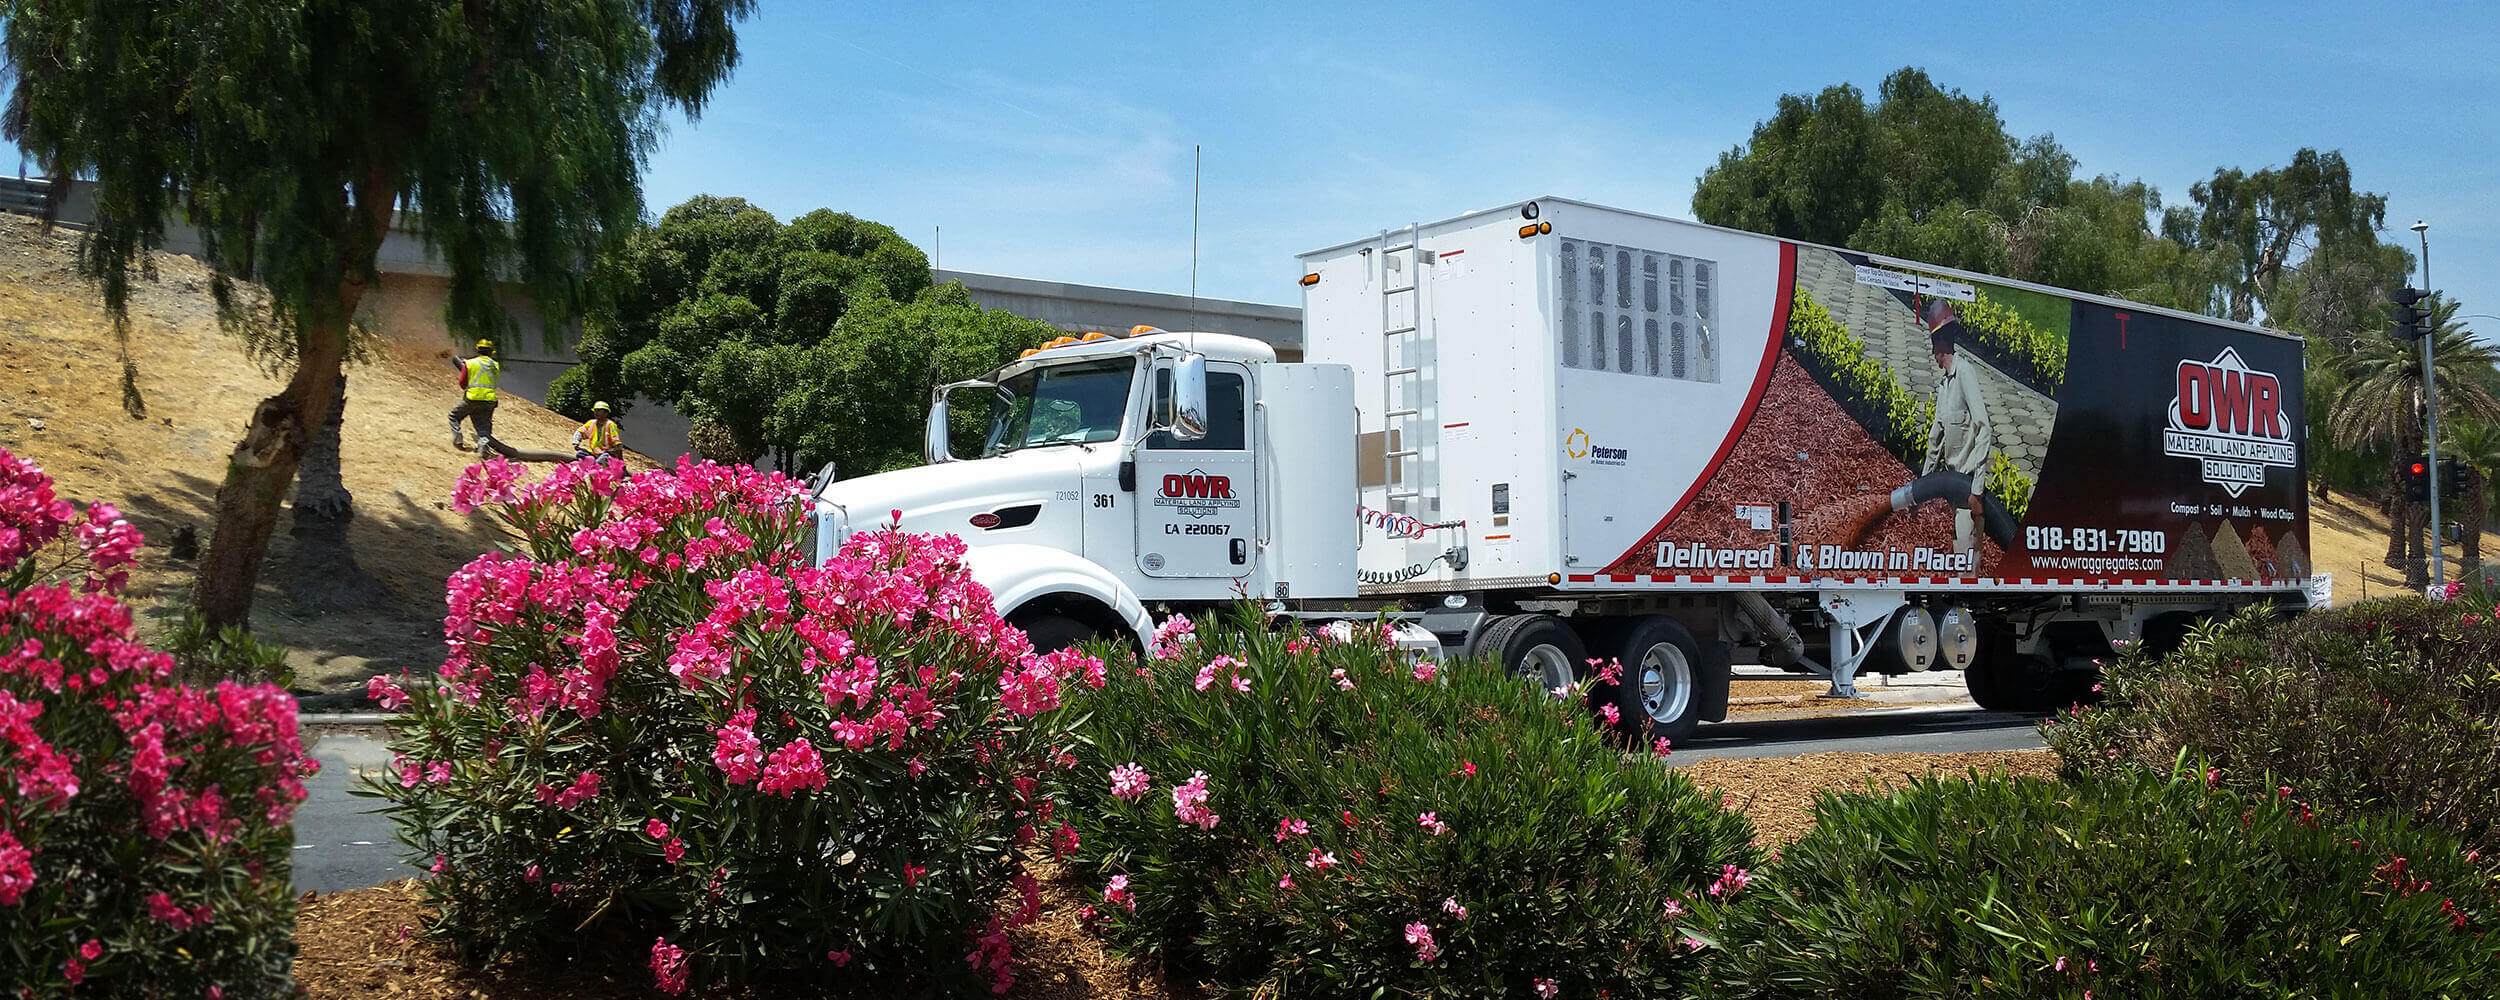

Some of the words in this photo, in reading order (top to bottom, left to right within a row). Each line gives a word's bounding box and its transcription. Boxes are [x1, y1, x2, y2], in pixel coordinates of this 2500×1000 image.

[2178, 362, 2282, 439] OWR
[1591, 445, 1627, 460] Peterson
[2167, 434, 2217, 454] MATERIAL
[2221, 441, 2246, 456] LAND
[2250, 444, 2293, 461] APPLYING
[2206, 462, 2261, 480] SOLUTIONS
[1163, 474, 1232, 499] OWR
[1093, 493, 1115, 508] 361
[2170, 501, 2199, 516] Compost
[2210, 504, 2222, 516] Soil
[2232, 505, 2251, 517] Mulch
[2260, 507, 2278, 519] Wood
[2278, 509, 2294, 522] Chips
[1165, 523, 1180, 535] CA
[1185, 524, 1231, 535] 220067
[2025, 525, 2166, 554] 818-831-7980
[1655, 541, 1776, 569] Delivered
[1796, 544, 1814, 570] &
[1818, 545, 1885, 570] Blown
[1888, 546, 1908, 570] in
[1912, 547, 1974, 571] Place!
[2031, 554, 2163, 575] www.owraggregates.com
[1276, 586, 1288, 596] 80
